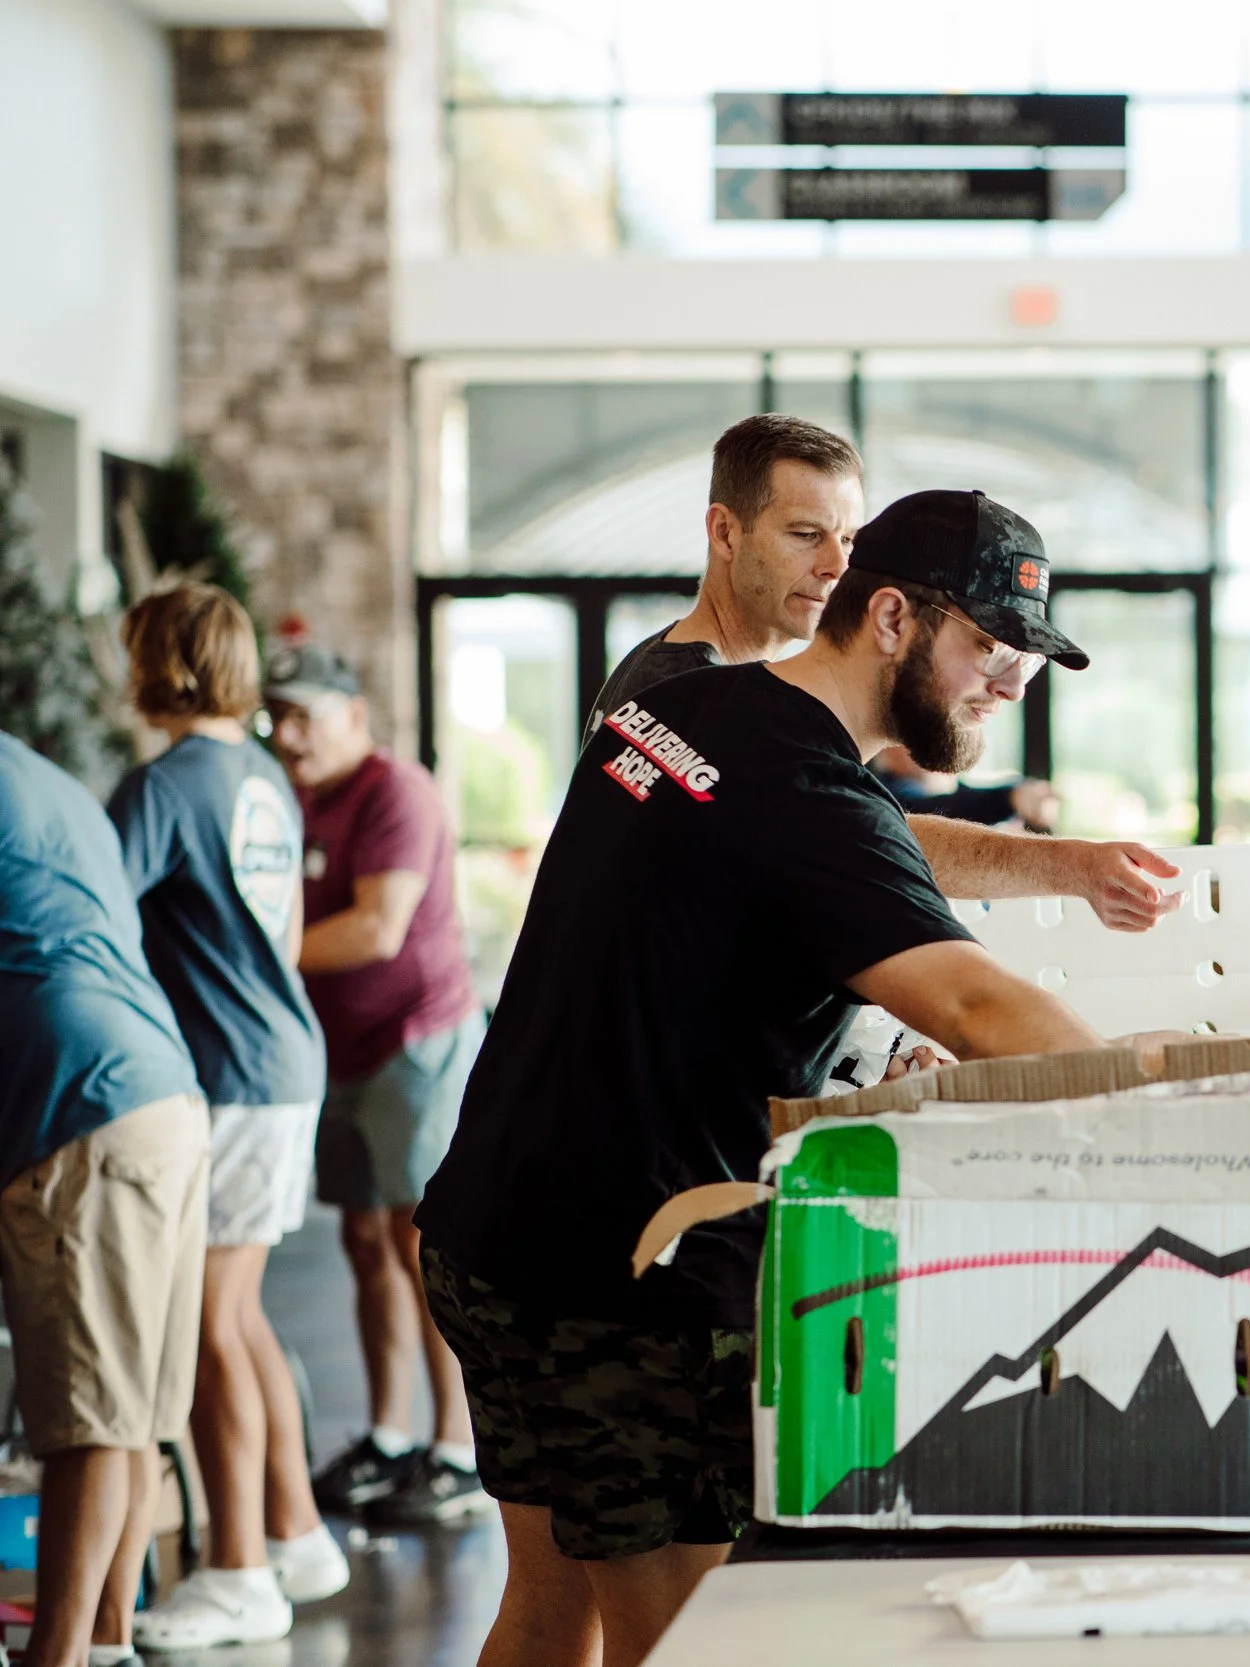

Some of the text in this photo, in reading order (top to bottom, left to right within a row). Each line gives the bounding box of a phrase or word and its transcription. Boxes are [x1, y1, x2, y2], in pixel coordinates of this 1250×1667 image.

[608, 700, 720, 792] DELIVERING
[610, 746, 662, 796] HOPE
[1030, 1151, 1070, 1170] the
[1078, 1151, 1105, 1168] to
